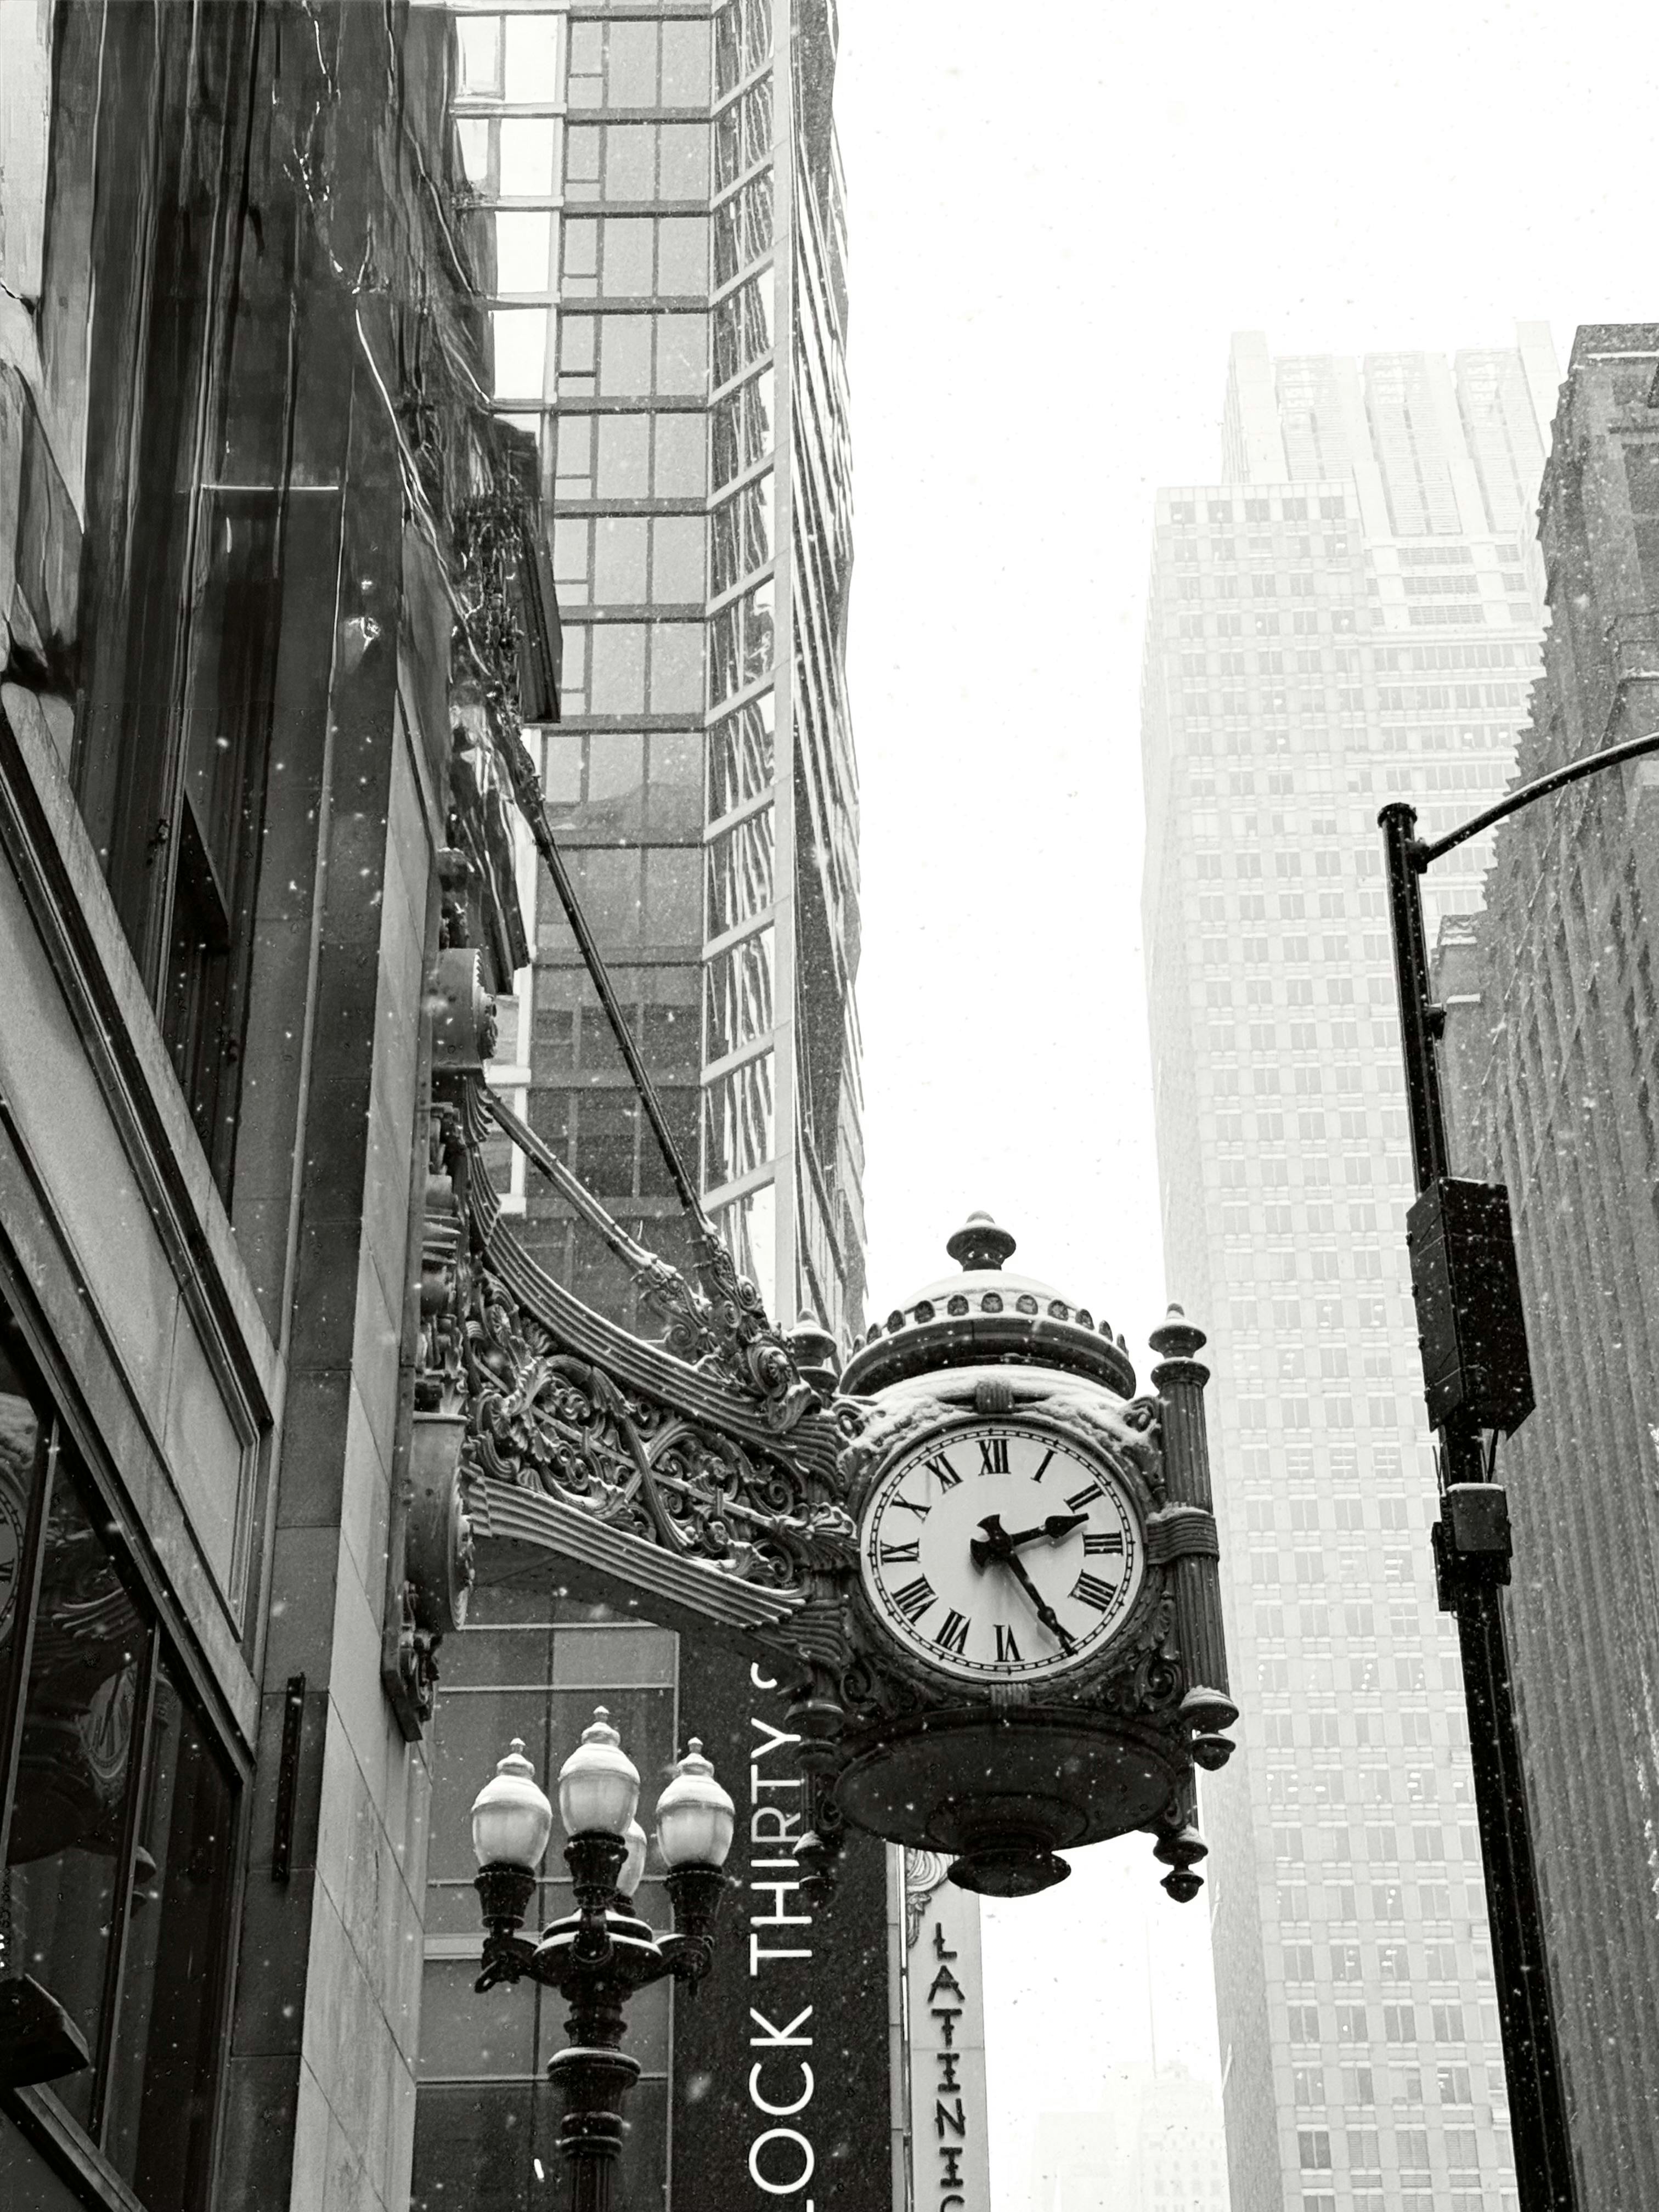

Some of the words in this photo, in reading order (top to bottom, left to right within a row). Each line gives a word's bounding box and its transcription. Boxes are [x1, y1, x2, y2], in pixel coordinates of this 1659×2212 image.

[922, 1451, 963, 1494] XI
[976, 1438, 1011, 1476] XII
[890, 1491, 932, 1523] X
[1064, 1481, 1106, 1513] II
[880, 1538, 921, 1565] IX
[1081, 1530, 1124, 1558] III
[890, 1573, 939, 1626] VIII
[932, 1607, 972, 1656] VII
[992, 1624, 1025, 1662] VI
[749, 1717, 813, 1976] THIRTY
